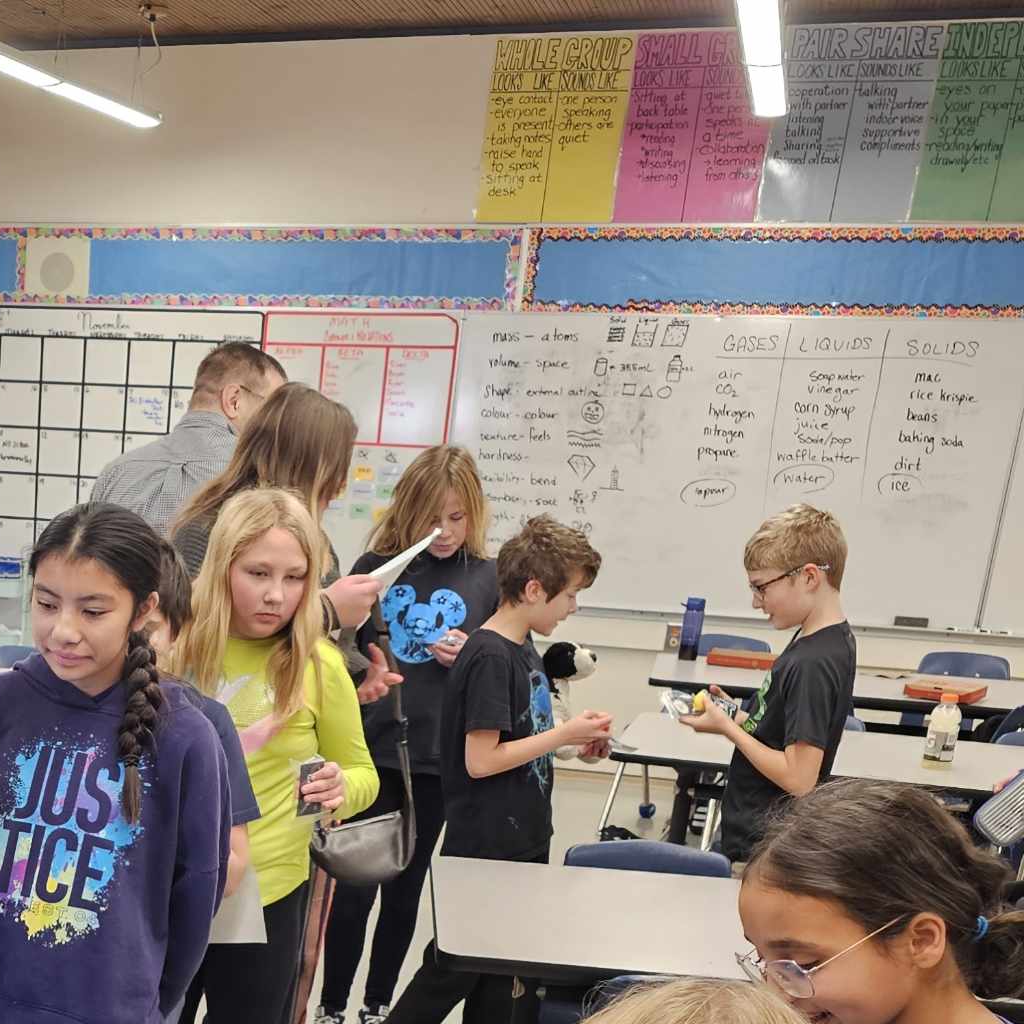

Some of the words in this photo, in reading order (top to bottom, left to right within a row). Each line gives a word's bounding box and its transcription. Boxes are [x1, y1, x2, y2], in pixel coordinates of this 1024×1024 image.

[635, 33, 703, 67] SMALL
[791, 27, 849, 59] PAIR
[850, 25, 944, 59] SHARE
[561, 36, 633, 71] GROUP
[788, 62, 825, 78] LOOKS
[828, 63, 855, 78] LIKE
[860, 62, 897, 78] SOUNDS
[899, 62, 925, 77] LIKE
[980, 60, 1011, 78] LIKE
[492, 72, 524, 91] LOOKS
[533, 72, 555, 90] LIKE
[597, 71, 619, 89] LIKE
[634, 70, 665, 87] LOOKS
[670, 70, 693, 87] LIKE
[583, 95, 618, 108] person
[562, 107, 612, 121] speaking
[900, 114, 924, 124] voice
[558, 131, 590, 151] quiet
[491, 161, 504, 173] to
[508, 160, 540, 174] speak
[529, 174, 543, 183] at
[488, 186, 517, 197] desk
[492, 330, 521, 343] mass
[540, 327, 580, 342] atoms
[723, 334, 780, 352] GASES
[799, 335, 873, 353] LIQUIDS
[906, 339, 980, 358] SOLIDS
[488, 352, 521, 368] volume
[536, 359, 570, 373] space
[718, 369, 744, 380] air
[914, 371, 942, 384] mac
[807, 383, 860, 402] vinegar
[909, 388, 934, 400] rice
[940, 388, 978, 406] krispie
[480, 406, 511, 420] colour
[523, 407, 559, 420] colour
[708, 403, 756, 424] hydrogen
[906, 407, 939, 423] beans
[528, 426, 552, 443] feels
[703, 424, 745, 444] nitrogen
[793, 418, 829, 436] juice
[898, 430, 935, 455] baking
[941, 434, 965, 448] soda
[776, 448, 818, 463] waffle
[894, 455, 922, 473] dirt
[529, 471, 558, 486] bend
[783, 471, 827, 485] water
[890, 479, 912, 492] ice
[13, 746, 121, 834] JUS
